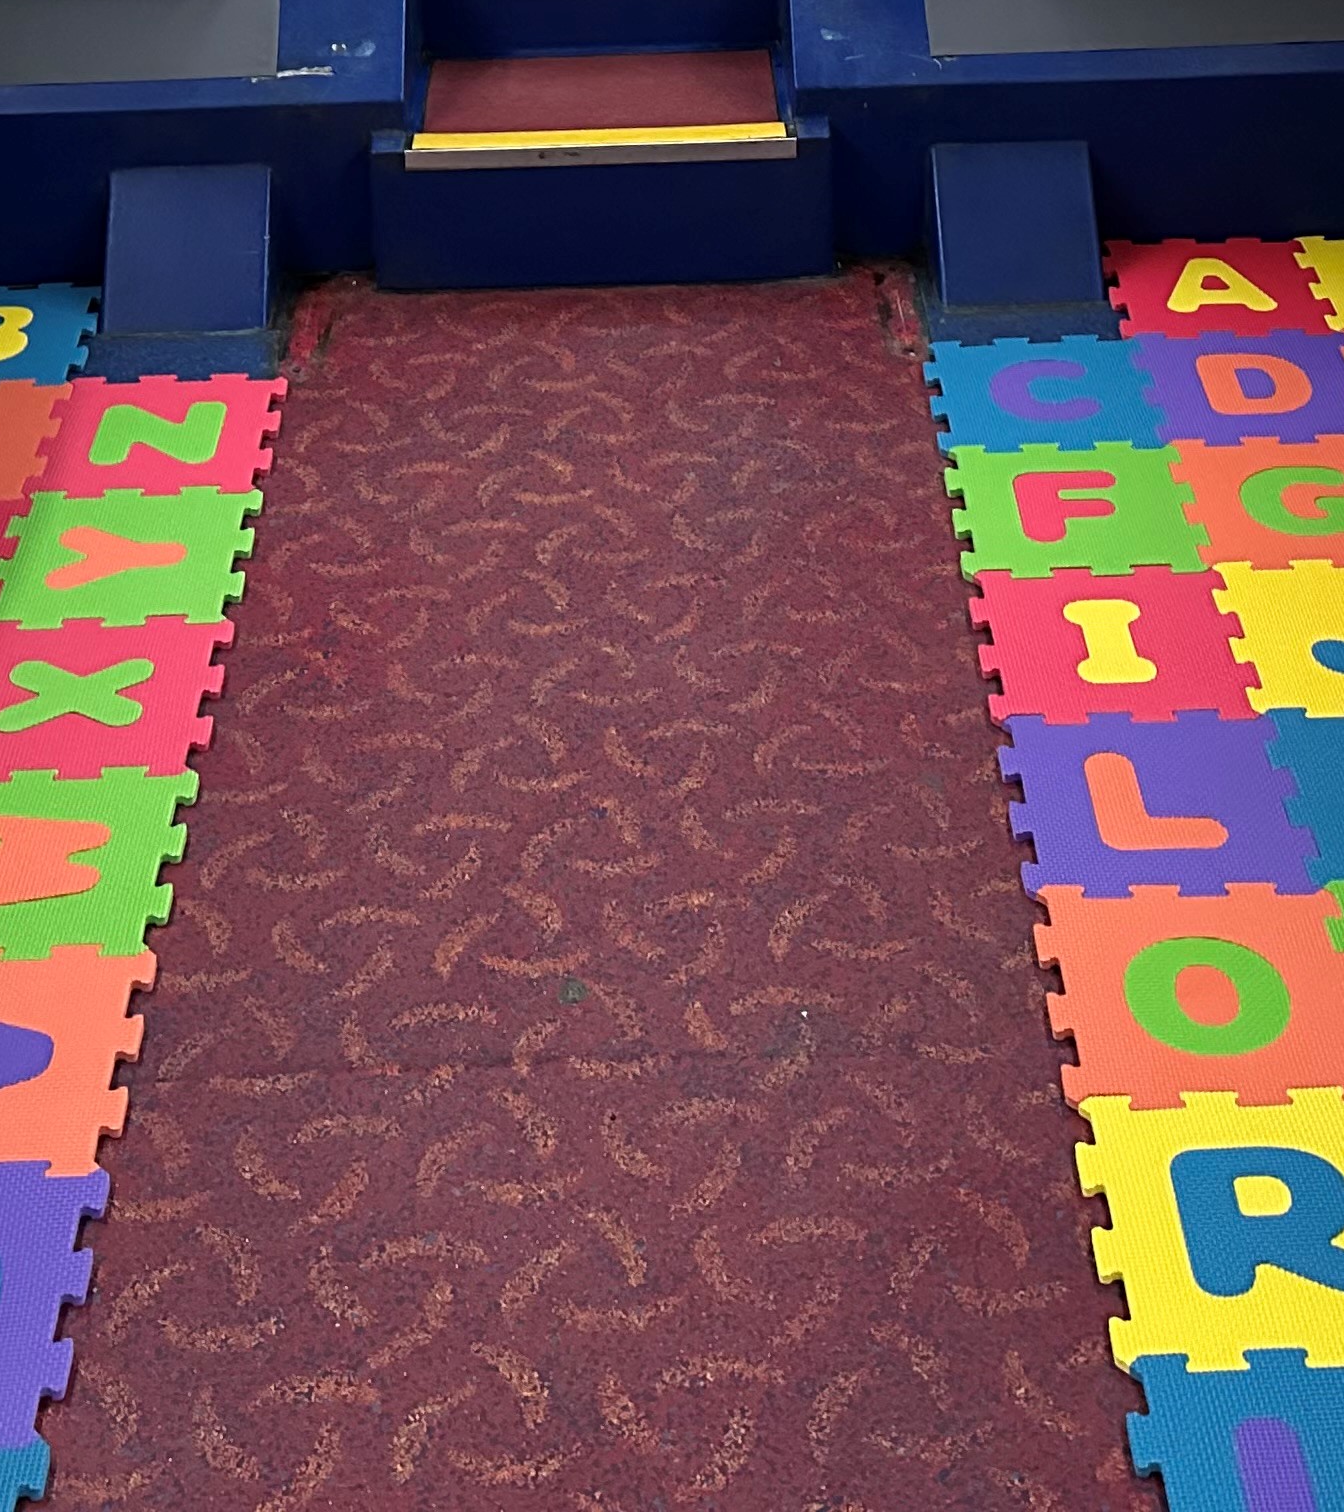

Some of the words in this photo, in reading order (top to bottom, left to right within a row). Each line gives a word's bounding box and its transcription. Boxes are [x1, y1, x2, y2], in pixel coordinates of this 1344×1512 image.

[1166, 256, 1279, 312] A
[989, 359, 1103, 422] C
[1196, 353, 1313, 416] D
[1012, 469, 1117, 544] F
[45, 525, 188, 591] Y
[1062, 598, 1158, 684] I
[1083, 750, 1230, 851] L
[1123, 935, 1292, 1057] O
